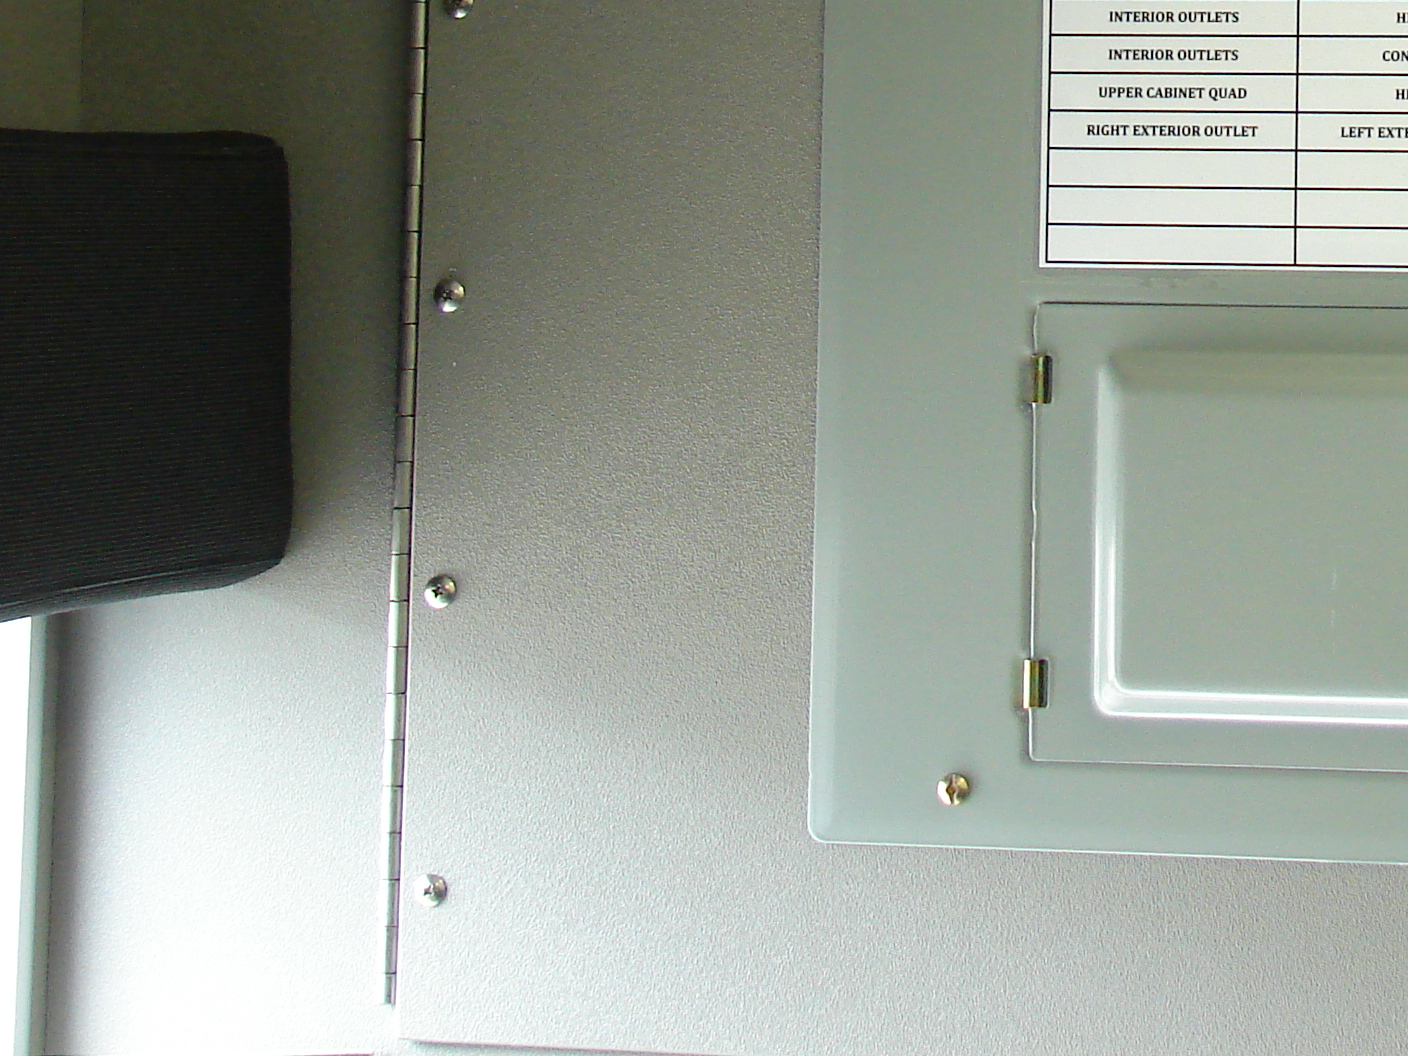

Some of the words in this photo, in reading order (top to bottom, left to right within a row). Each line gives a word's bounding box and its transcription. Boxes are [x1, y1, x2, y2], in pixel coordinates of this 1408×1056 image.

[1109, 11, 1174, 23] INTERIOR
[1178, 11, 1239, 23] OUTLETS
[1108, 49, 1174, 61] INTERIOR
[1177, 49, 1239, 61] OUTLETS
[1098, 87, 1143, 99] UPPER
[1146, 87, 1205, 99] CABINET
[1208, 87, 1248, 101] QUAD
[1086, 125, 1129, 136] RIGHT
[1132, 125, 1200, 137] EXTERIOR
[1203, 125, 1258, 137] OUTLET
[1340, 127, 1374, 138] LEFT
